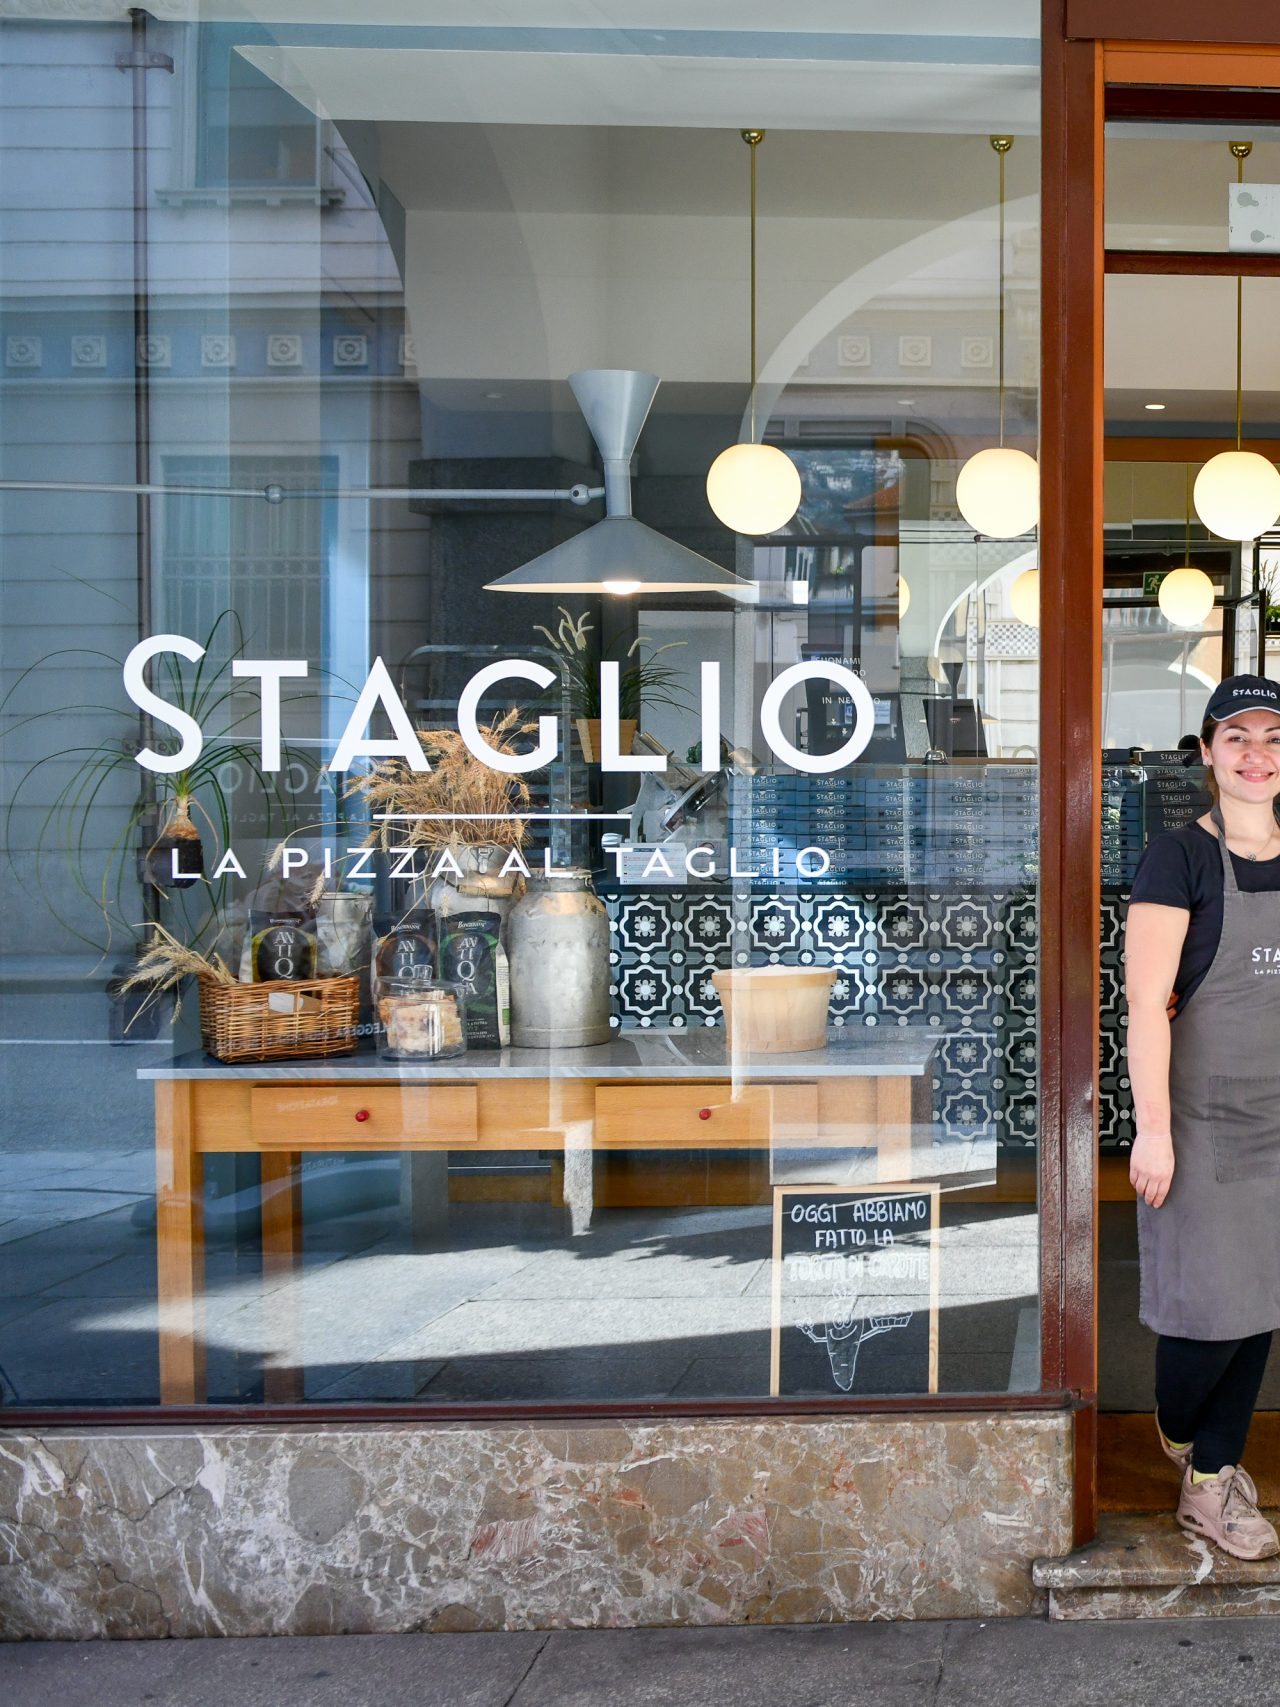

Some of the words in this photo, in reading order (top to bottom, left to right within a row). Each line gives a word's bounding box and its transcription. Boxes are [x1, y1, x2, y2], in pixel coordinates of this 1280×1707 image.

[123, 634, 875, 773] STAGLIO
[1232, 688, 1277, 699] STAGLIO
[172, 847, 246, 879] LA
[282, 847, 464, 879] PIZZA
[498, 847, 573, 878] AL
[605, 846, 830, 878] TAGLIO
[274, 957, 294, 979] Q
[457, 960, 476, 982] Q
[790, 1203, 837, 1223] OGGI
[852, 1200, 926, 1222] ABBIAMO
[815, 1228, 867, 1248] FATTO
[873, 1228, 895, 1246] LA
